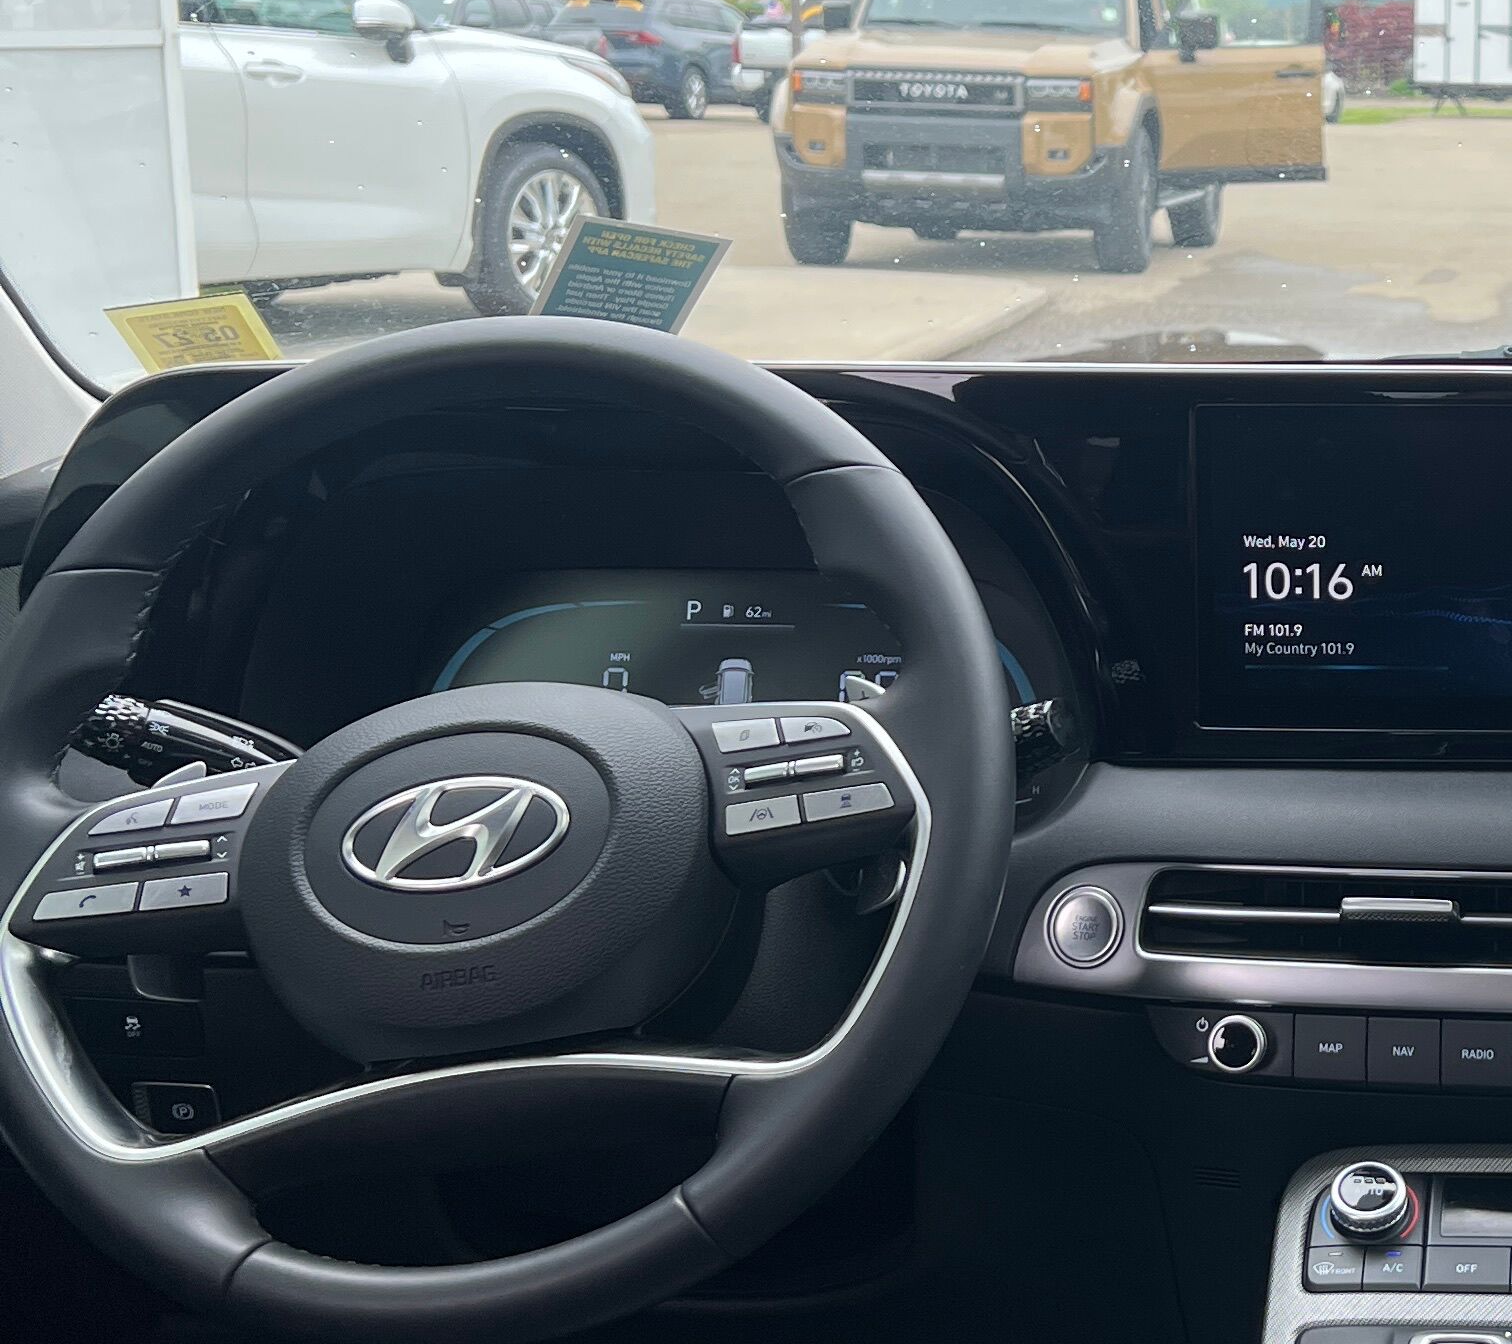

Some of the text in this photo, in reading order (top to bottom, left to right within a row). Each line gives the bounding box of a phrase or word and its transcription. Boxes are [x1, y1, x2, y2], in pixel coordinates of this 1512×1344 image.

[900, 82, 969, 100] TOYOTA
[1243, 535, 1326, 550] Wed, May 20
[1243, 562, 1383, 600] 10:16 AM
[686, 600, 702, 620] P
[1244, 624, 1303, 637] FM 101.9
[1244, 642, 1355, 656] My Country 101.9
[610, 652, 631, 662] MPH
[199, 800, 229, 810] MODE
[1071, 922, 1100, 931] START
[1071, 931, 1096, 941] STOP
[420, 964, 497, 990] AIRBAG
[1319, 1042, 1343, 1054] MAP
[1392, 1046, 1414, 1057] NAV
[1461, 1049, 1494, 1060] RADIO
[1382, 1262, 1404, 1273] A/C
[1456, 1263, 1478, 1273] OFF
